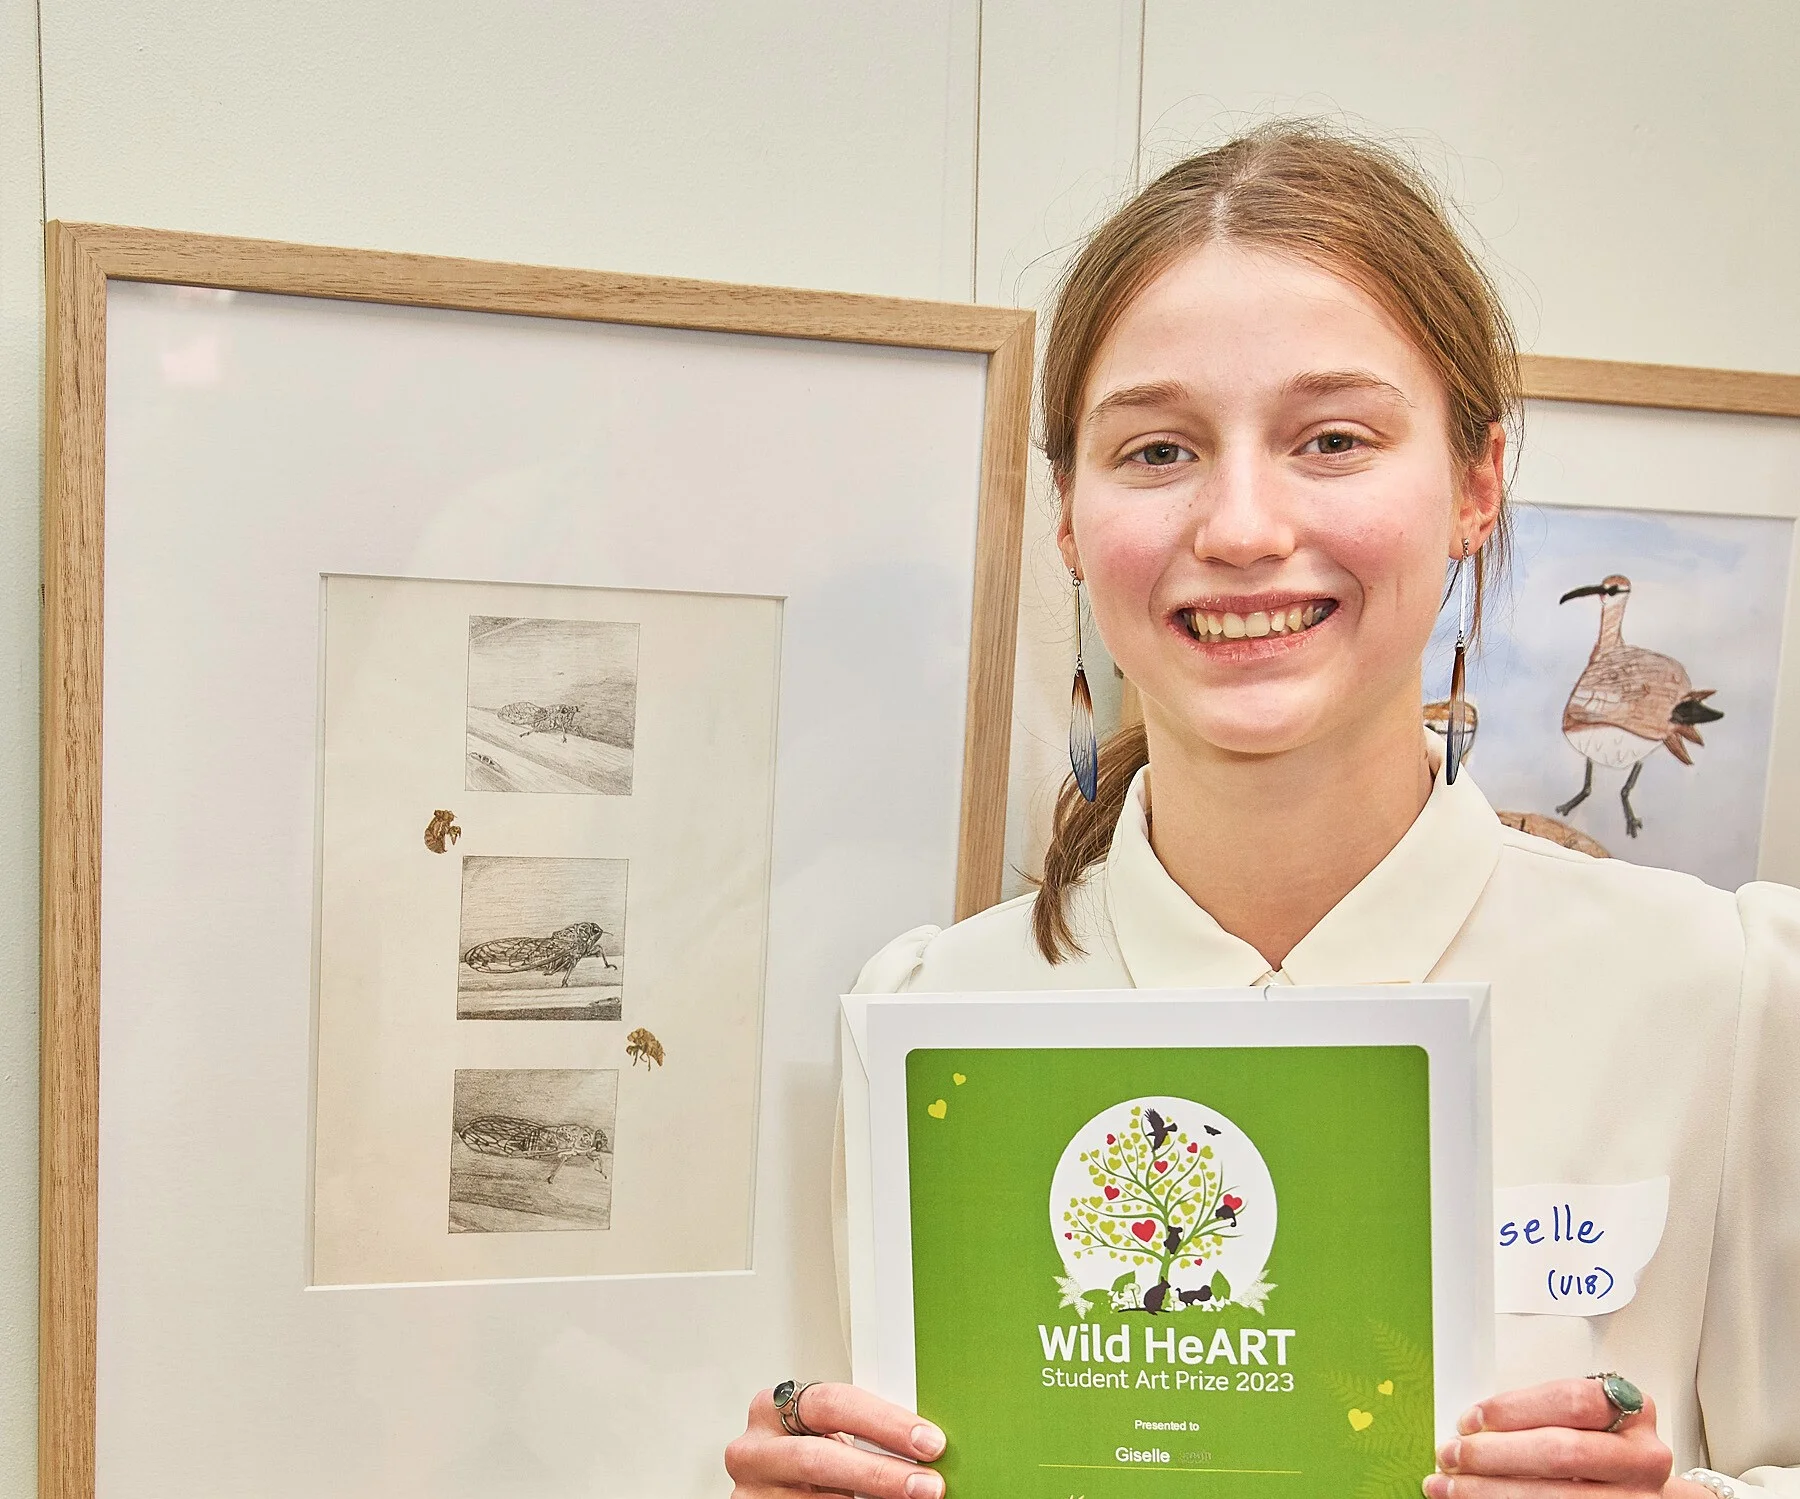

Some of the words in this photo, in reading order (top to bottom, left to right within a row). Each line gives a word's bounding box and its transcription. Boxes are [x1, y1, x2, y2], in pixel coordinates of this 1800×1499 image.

[1499, 1204, 1605, 1247] selle
[1548, 1266, 1614, 1300] (U18)
[1038, 1323, 1131, 1363] Wild
[1145, 1327, 1296, 1366] HeART
[1041, 1367, 1129, 1390] Student
[1135, 1370, 1170, 1390] Art
[1176, 1370, 1229, 1391] Prize
[1235, 1372, 1295, 1392] 2023
[1134, 1419, 1187, 1431] Presented
[1189, 1421, 1200, 1431] to
[1115, 1446, 1171, 1463] Giselle
